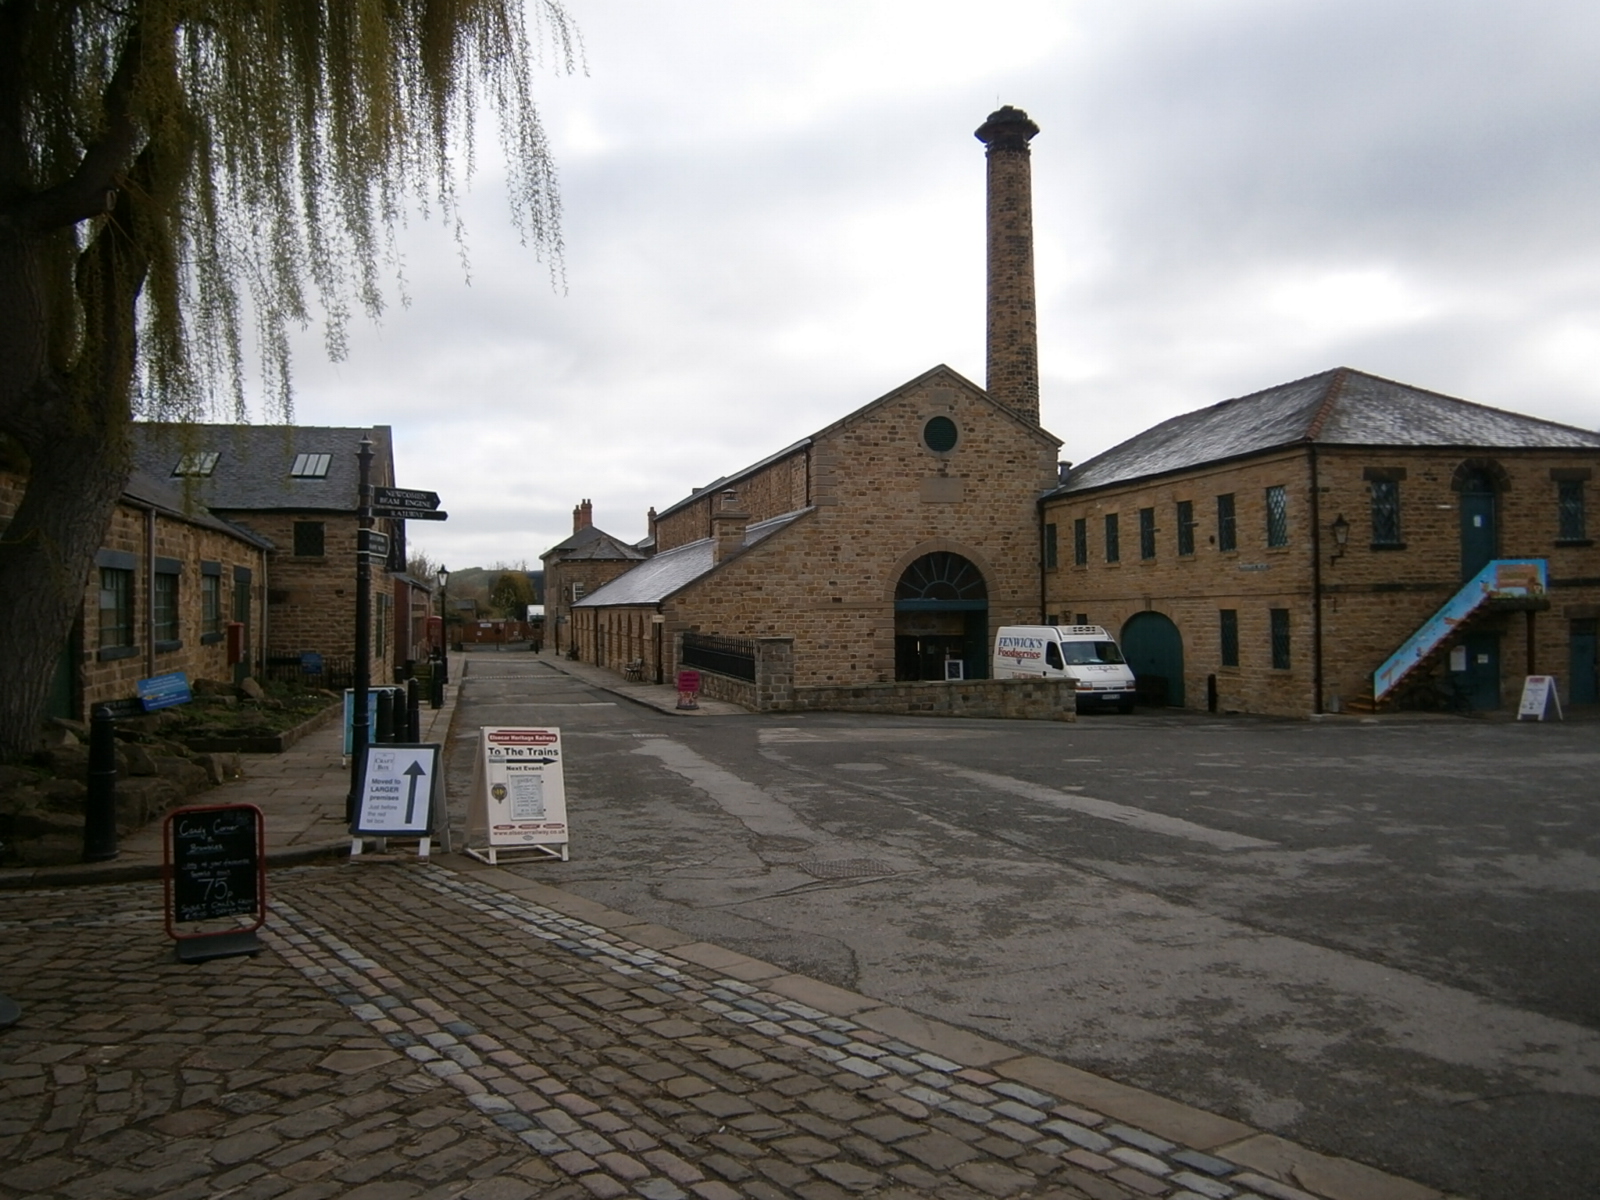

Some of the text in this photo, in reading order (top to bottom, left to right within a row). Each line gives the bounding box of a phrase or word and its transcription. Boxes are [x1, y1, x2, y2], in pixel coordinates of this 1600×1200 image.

[385, 490, 427, 499] NEWCOMEN
[379, 497, 431, 508] BEAM ENGINE
[390, 510, 424, 518] RAILWAY
[999, 637, 1043, 648] FENWICK'S
[997, 646, 1041, 659] Foodservice
[510, 734, 534, 742] Heritage
[535, 734, 556, 742] Railway
[488, 747, 559, 756] To The Trains
[369, 794, 399, 802] premises
[197, 877, 234, 904] 75p
